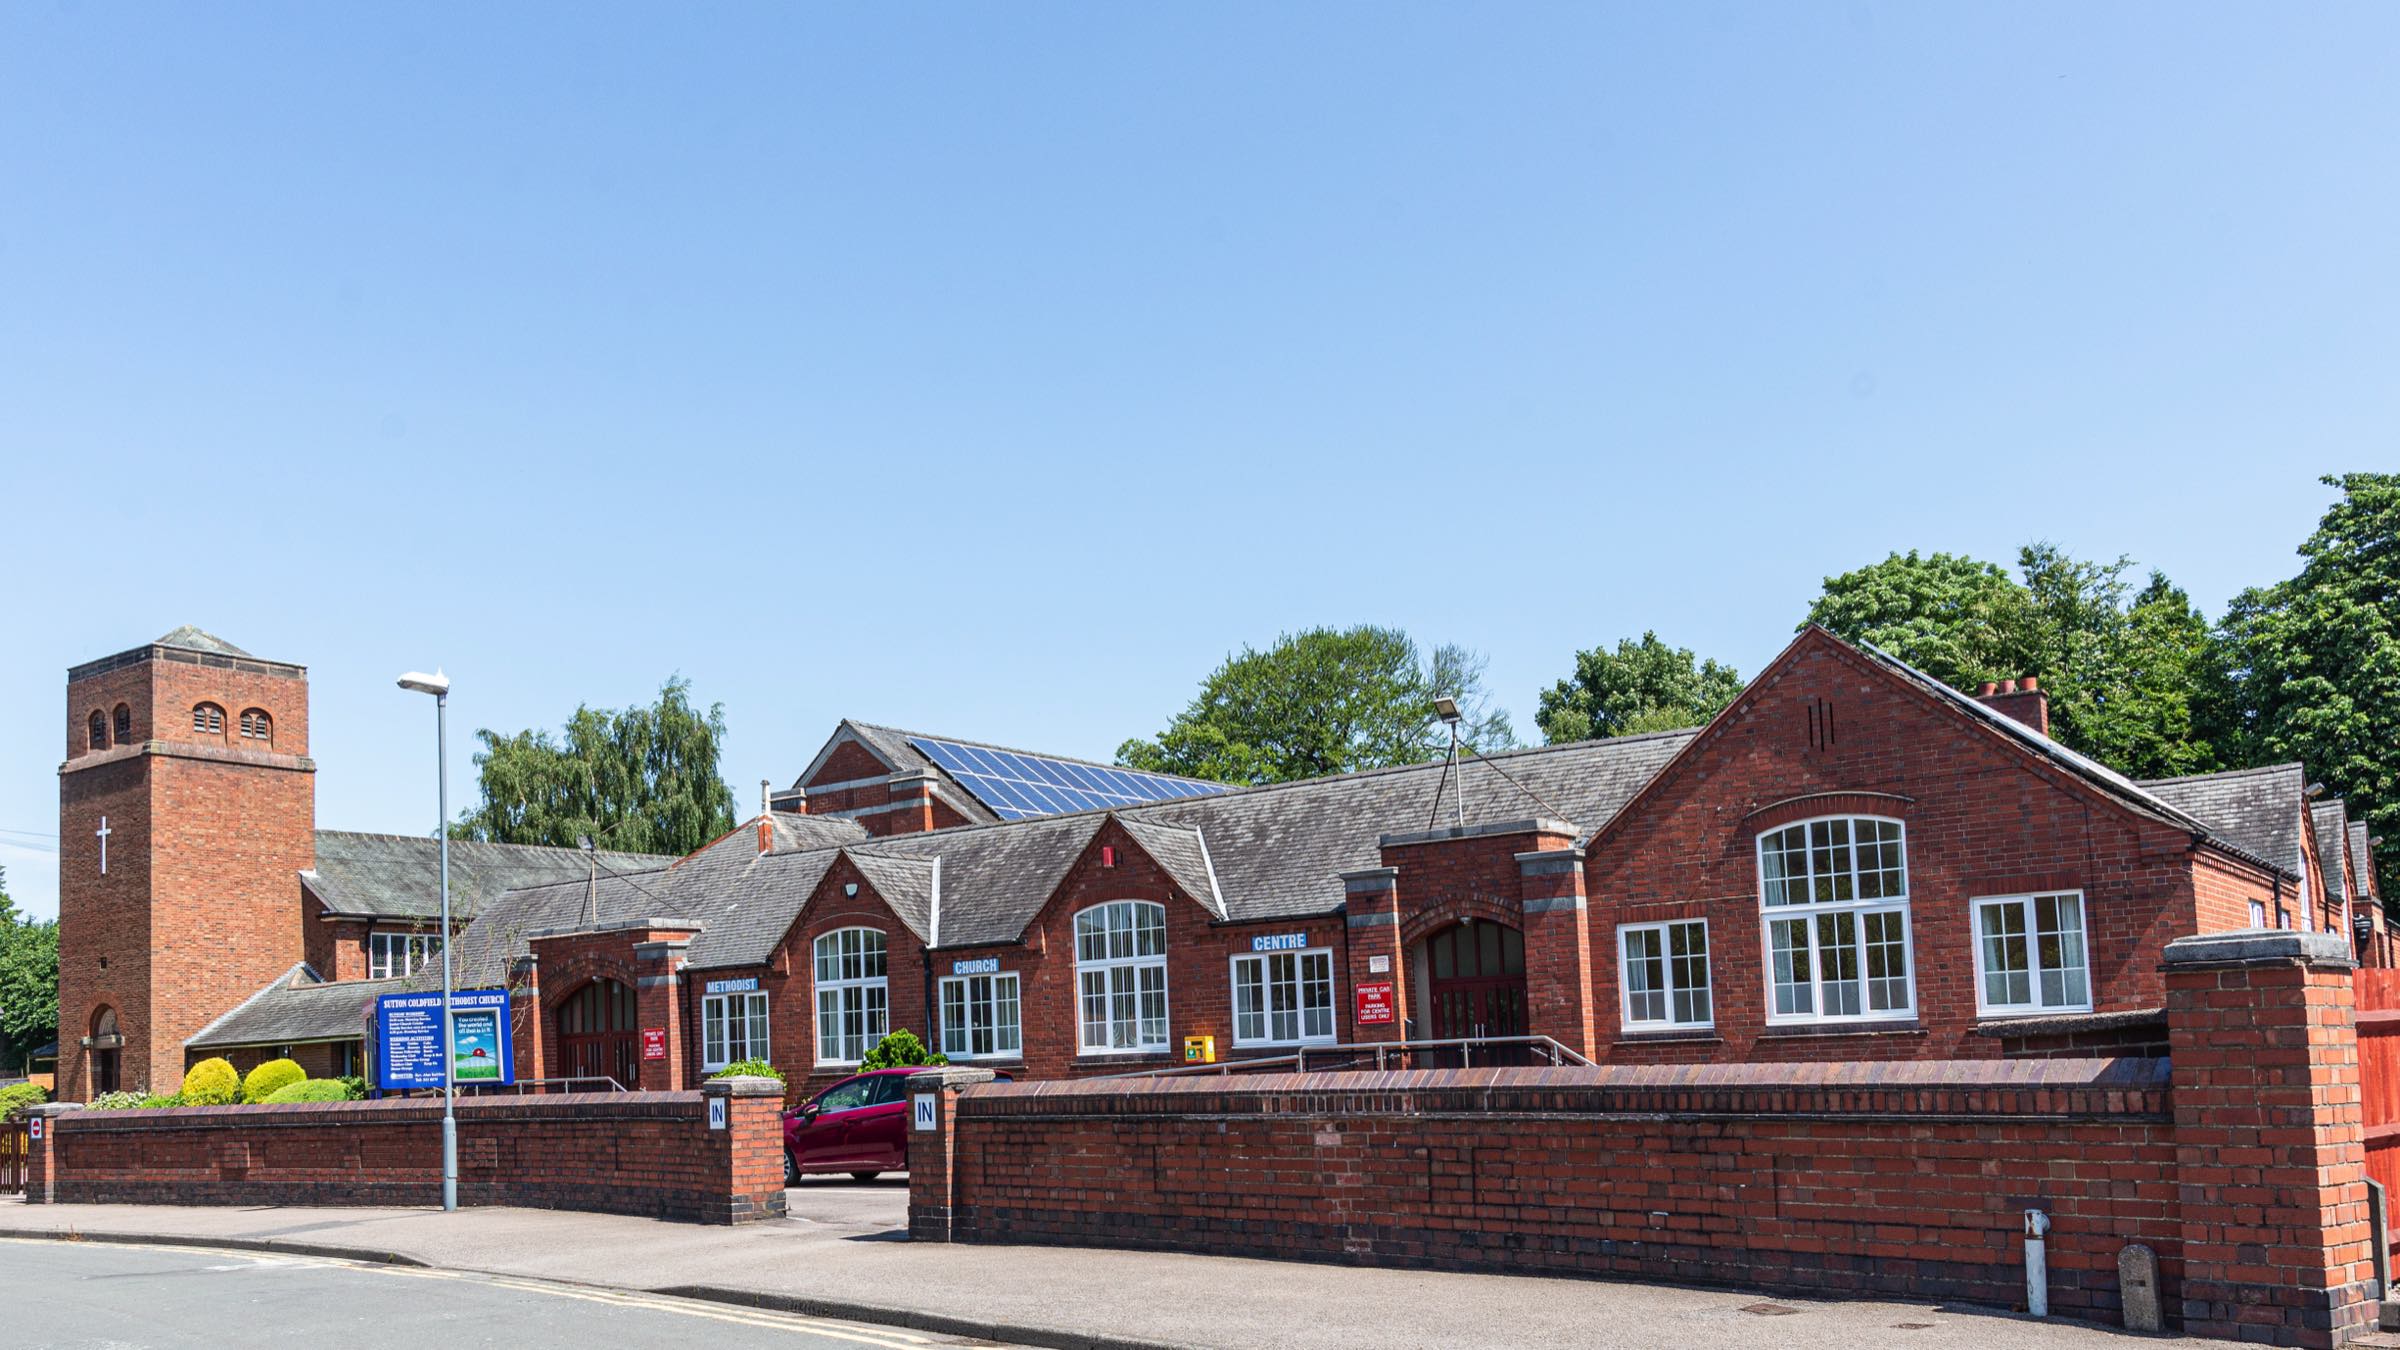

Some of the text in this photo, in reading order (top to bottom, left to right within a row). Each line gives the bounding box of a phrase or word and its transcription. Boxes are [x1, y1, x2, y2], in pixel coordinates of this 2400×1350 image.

[1254, 933, 1305, 950] CENTRE
[955, 958, 997, 974] CHURCH
[707, 978, 756, 993] METHODIST
[383, 999, 407, 1008] SUTTON
[407, 998, 442, 1007] COLDFIELD
[479, 995, 505, 1005] CHURCH
[712, 1104, 723, 1122] IN
[918, 1102, 932, 1122] IN
